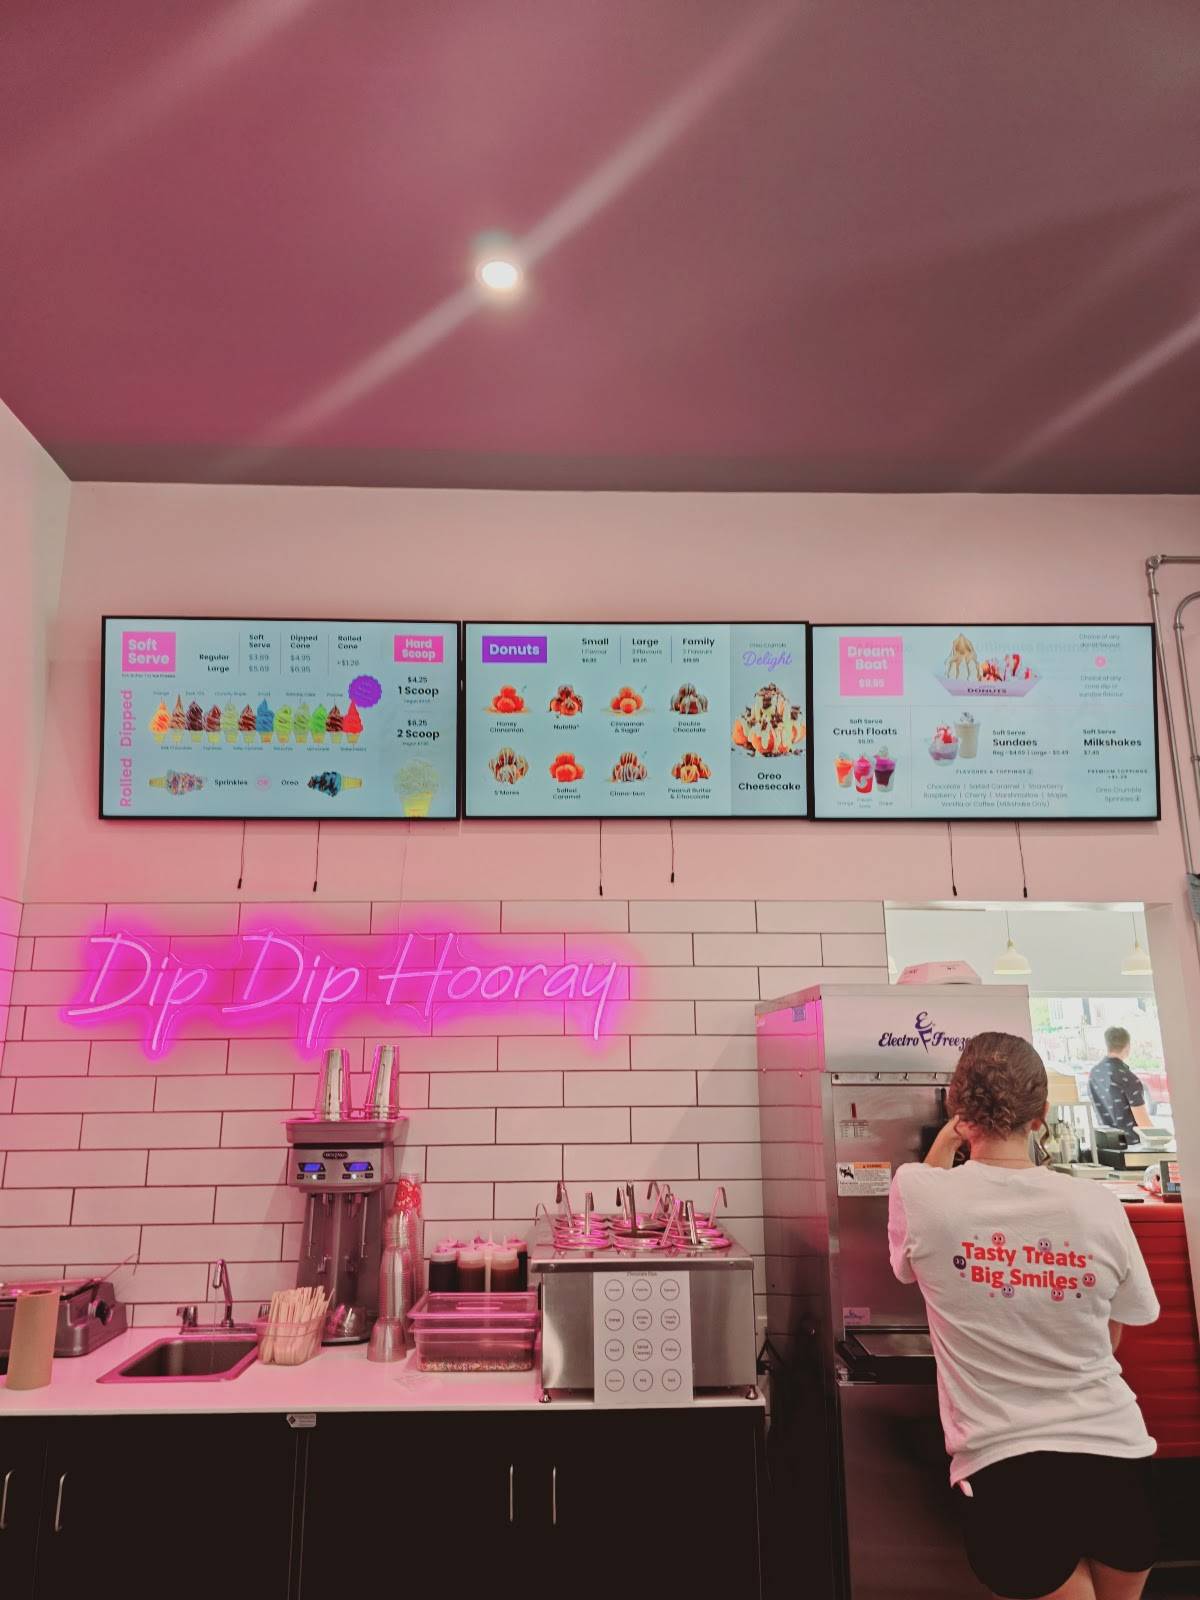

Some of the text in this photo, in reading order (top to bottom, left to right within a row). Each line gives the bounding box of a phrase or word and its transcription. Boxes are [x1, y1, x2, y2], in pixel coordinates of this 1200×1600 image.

[128, 638, 158, 651] Soft
[406, 638, 432, 648] Hard
[632, 638, 659, 648] Large
[682, 638, 715, 648] Family
[402, 650, 436, 661] Scoop
[489, 644, 540, 656] Donuts
[848, 646, 896, 658] Dream
[128, 652, 170, 664] Serve
[199, 654, 230, 662] Regular
[742, 650, 792, 672] Delight
[207, 665, 230, 673] Large
[855, 659, 888, 670] Boat
[404, 686, 439, 697] Scoop
[119, 689, 136, 747] Dipped
[396, 730, 440, 740] 2 Scoop
[866, 728, 898, 736] Floats
[992, 738, 1038, 746] Sundaes
[1084, 738, 1142, 746] Milkshakes
[757, 772, 782, 780] Oreo
[120, 758, 133, 807] Rolled
[738, 783, 801, 791] Cheesecake
[68, 931, 617, 1050] Dip Dip Hooray
[878, 1032, 968, 1052] Electro Freez
[961, 1242, 1087, 1268] Tasty Treats
[970, 1266, 1078, 1290] Big Smiles
